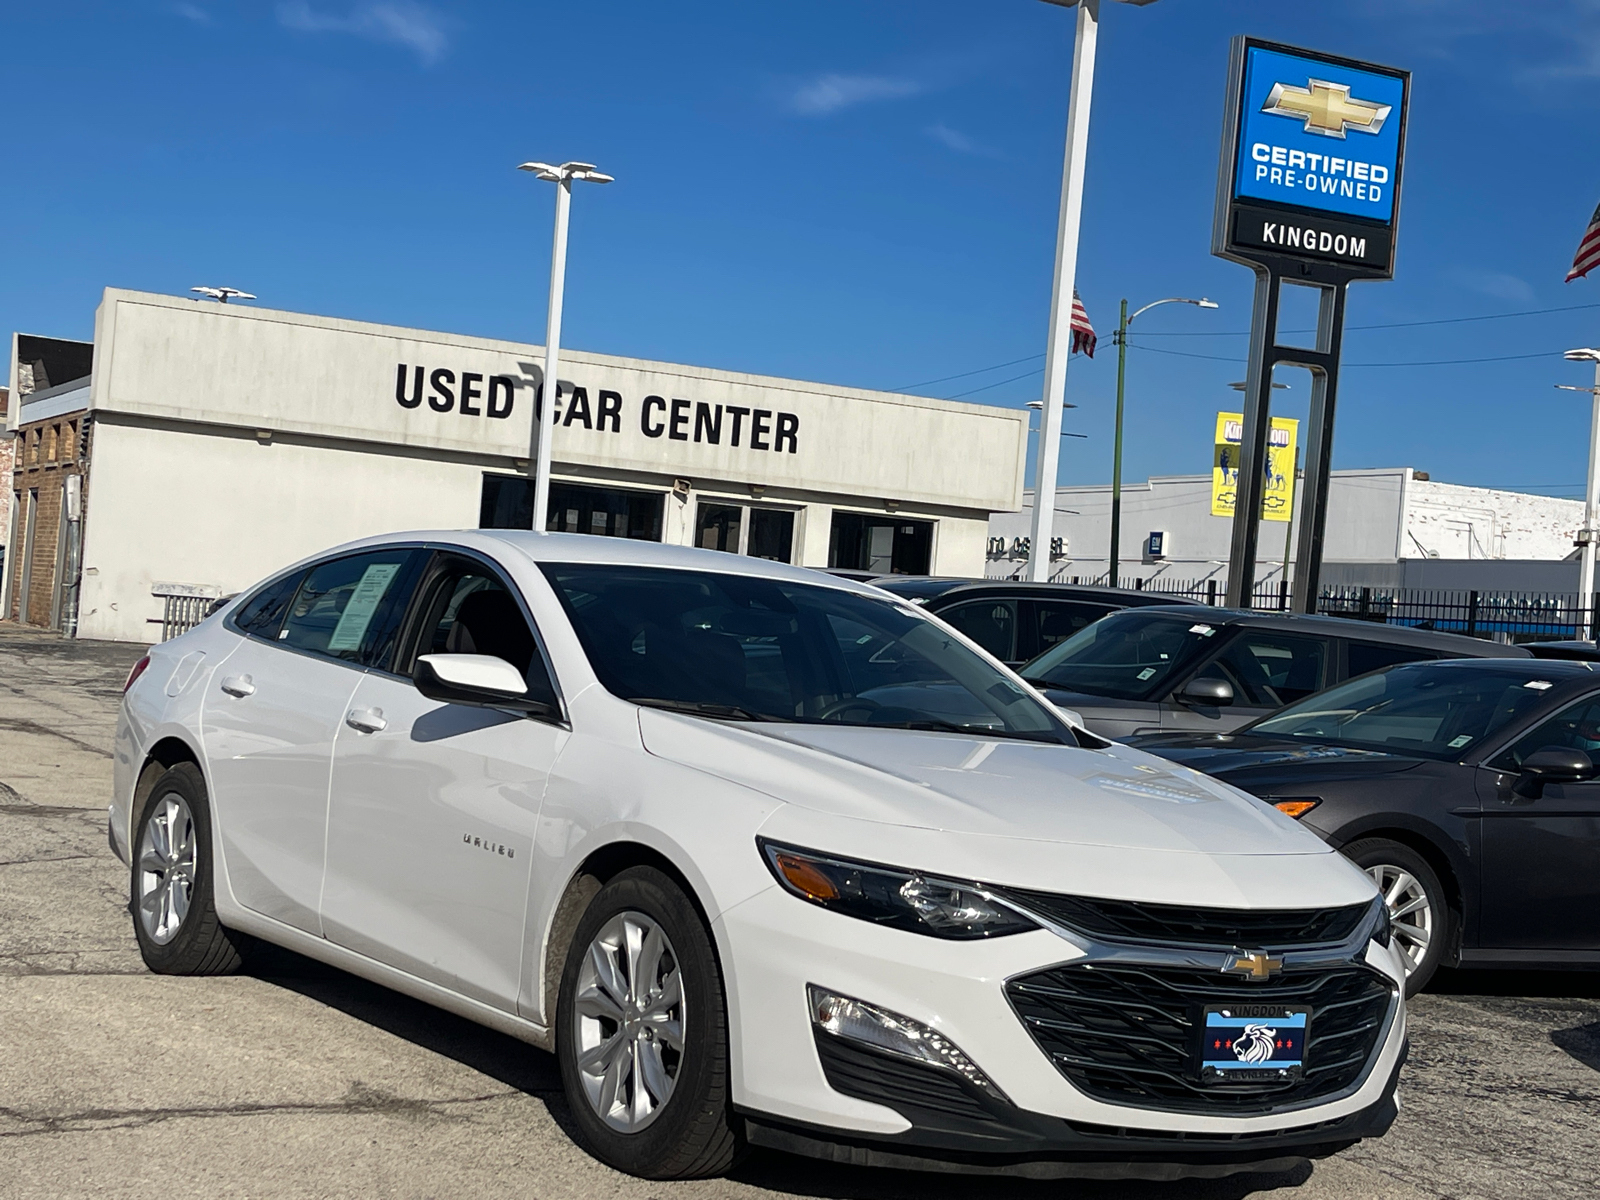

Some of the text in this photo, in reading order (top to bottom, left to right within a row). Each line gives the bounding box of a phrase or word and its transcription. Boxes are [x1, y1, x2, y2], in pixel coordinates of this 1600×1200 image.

[1252, 143, 1389, 184] CERTIFIED
[1255, 164, 1382, 202] PRE-OWNED
[1262, 222, 1366, 258] KINGDOM
[395, 363, 514, 419] USED
[640, 395, 800, 454] CENTER
[1230, 1005, 1287, 1017] KINGDOM
